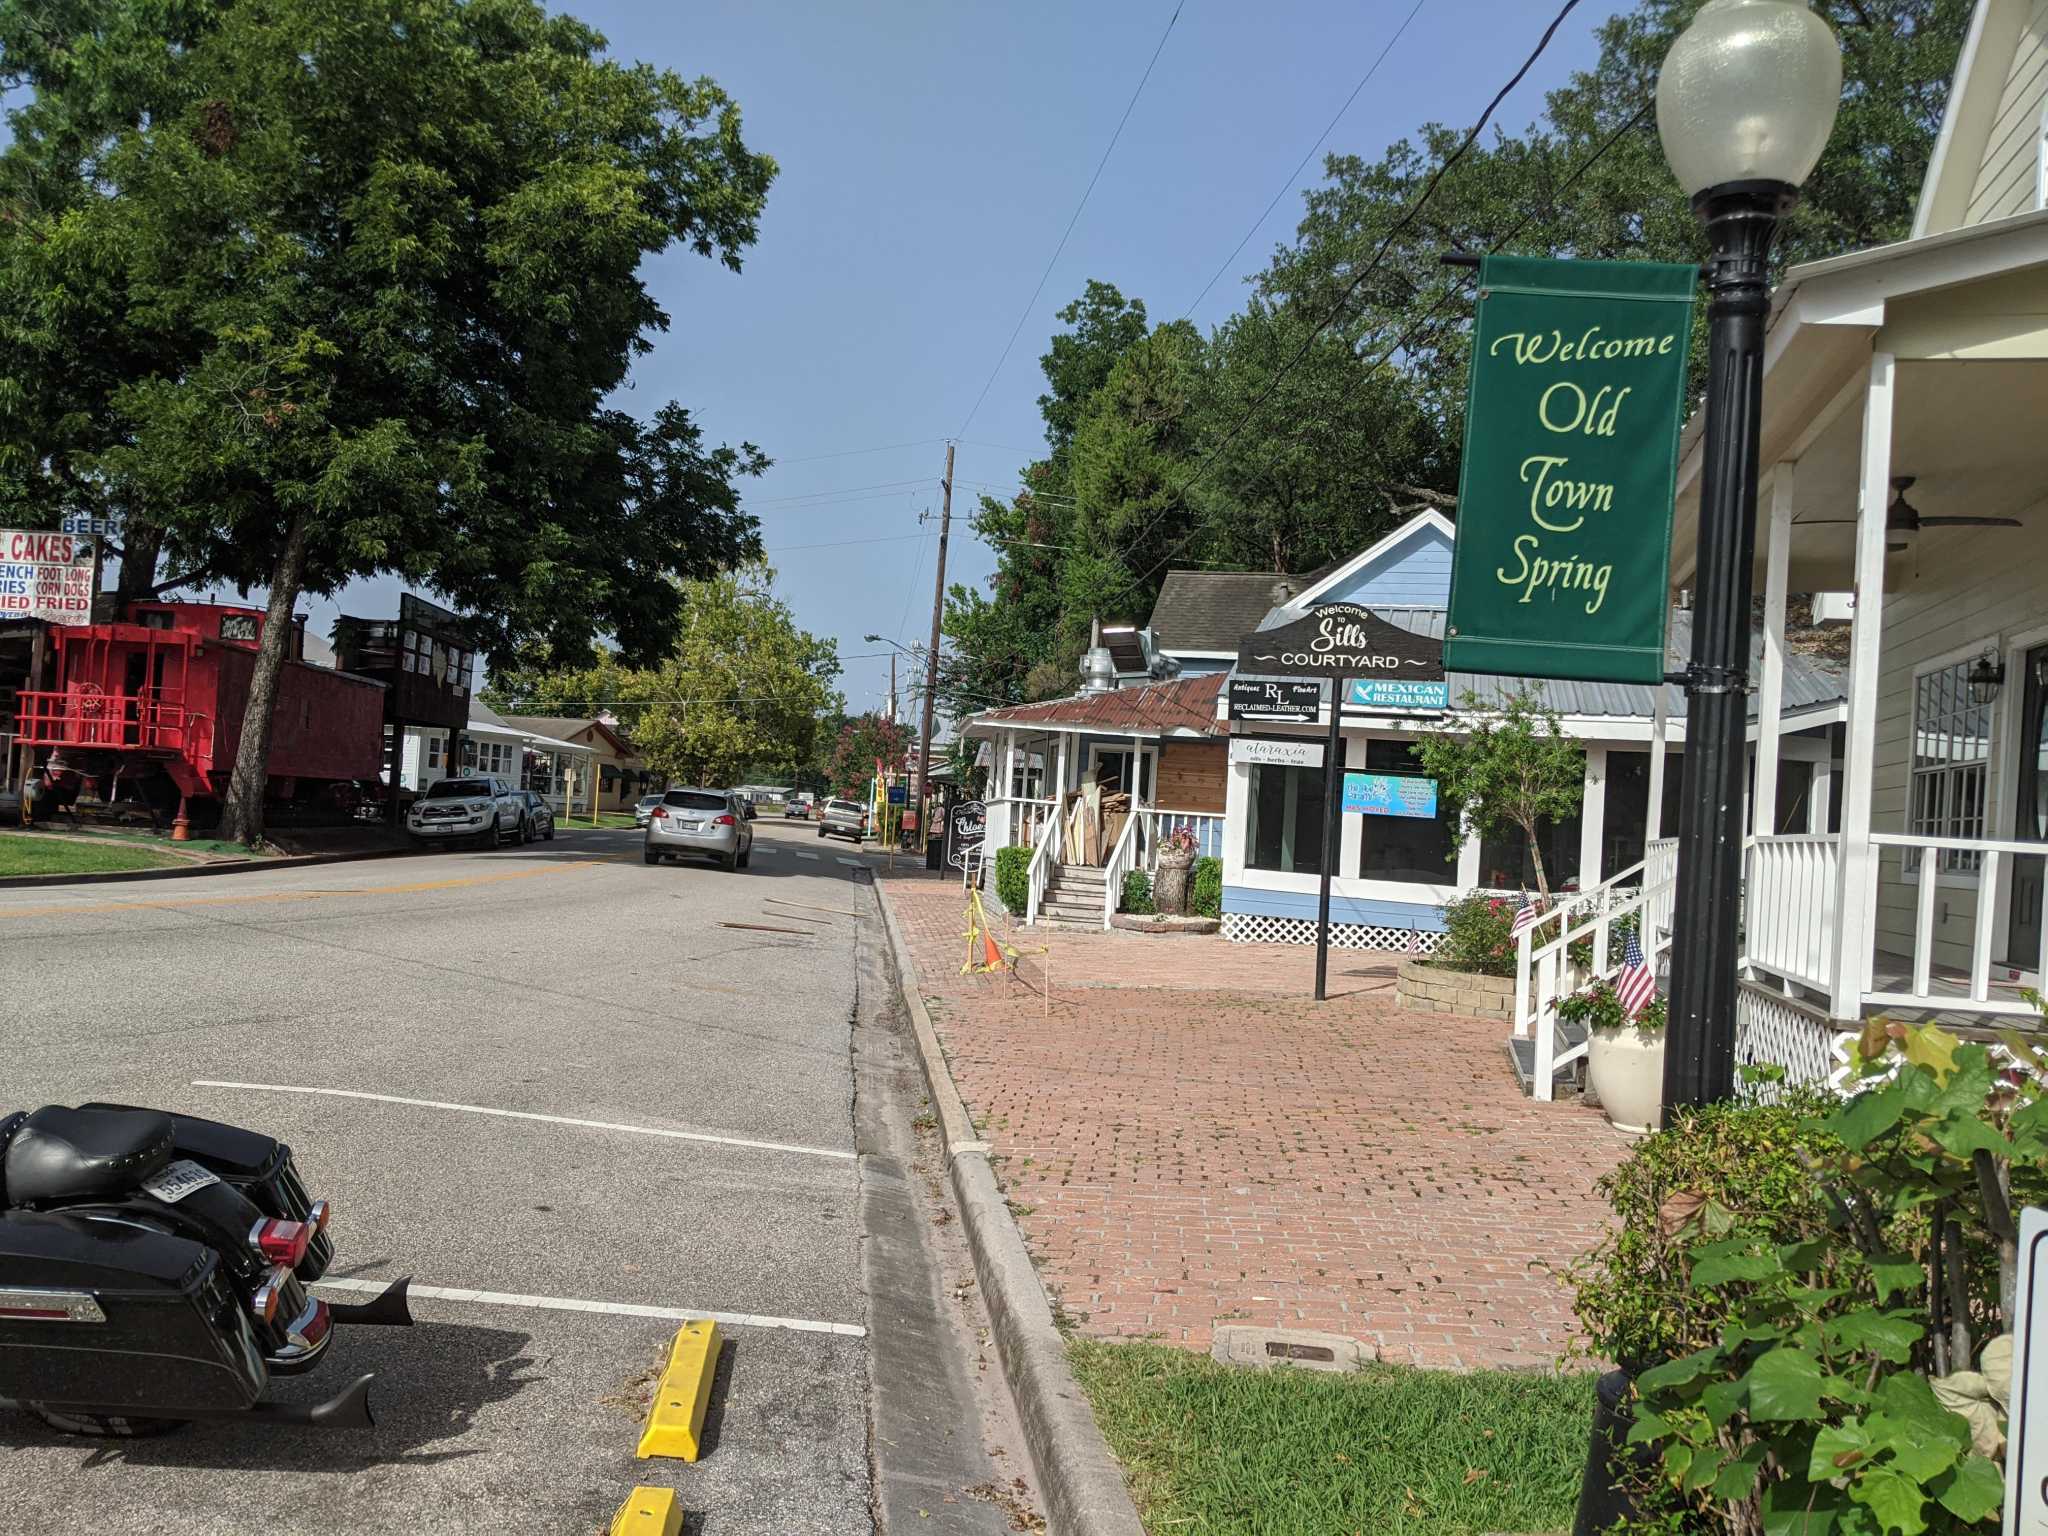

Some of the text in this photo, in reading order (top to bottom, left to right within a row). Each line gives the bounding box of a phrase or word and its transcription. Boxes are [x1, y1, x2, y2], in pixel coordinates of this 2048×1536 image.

[1490, 326, 1675, 364] Welcome
[1538, 381, 1631, 437] Old
[1519, 456, 1614, 532] Town
[63, 519, 118, 534] BEER
[11, 534, 73, 563] CAKES
[37, 566, 91, 582] FOOT LONG
[1497, 535, 1612, 615] Spring
[36, 582, 89, 597] CORN DOGS
[36, 597, 88, 610] FRIED
[1315, 604, 1368, 619] Welcome
[1310, 617, 1368, 652] Sills
[1281, 653, 1399, 669] COURTYARD
[1233, 683, 1260, 693] Antiques
[1375, 683, 1444, 696] MEXICAN
[1373, 692, 1444, 705] RESTAURANT
[1233, 703, 1317, 713] RECLAIMED-LEATHER.COM
[1246, 742, 1306, 757] ataraxia
